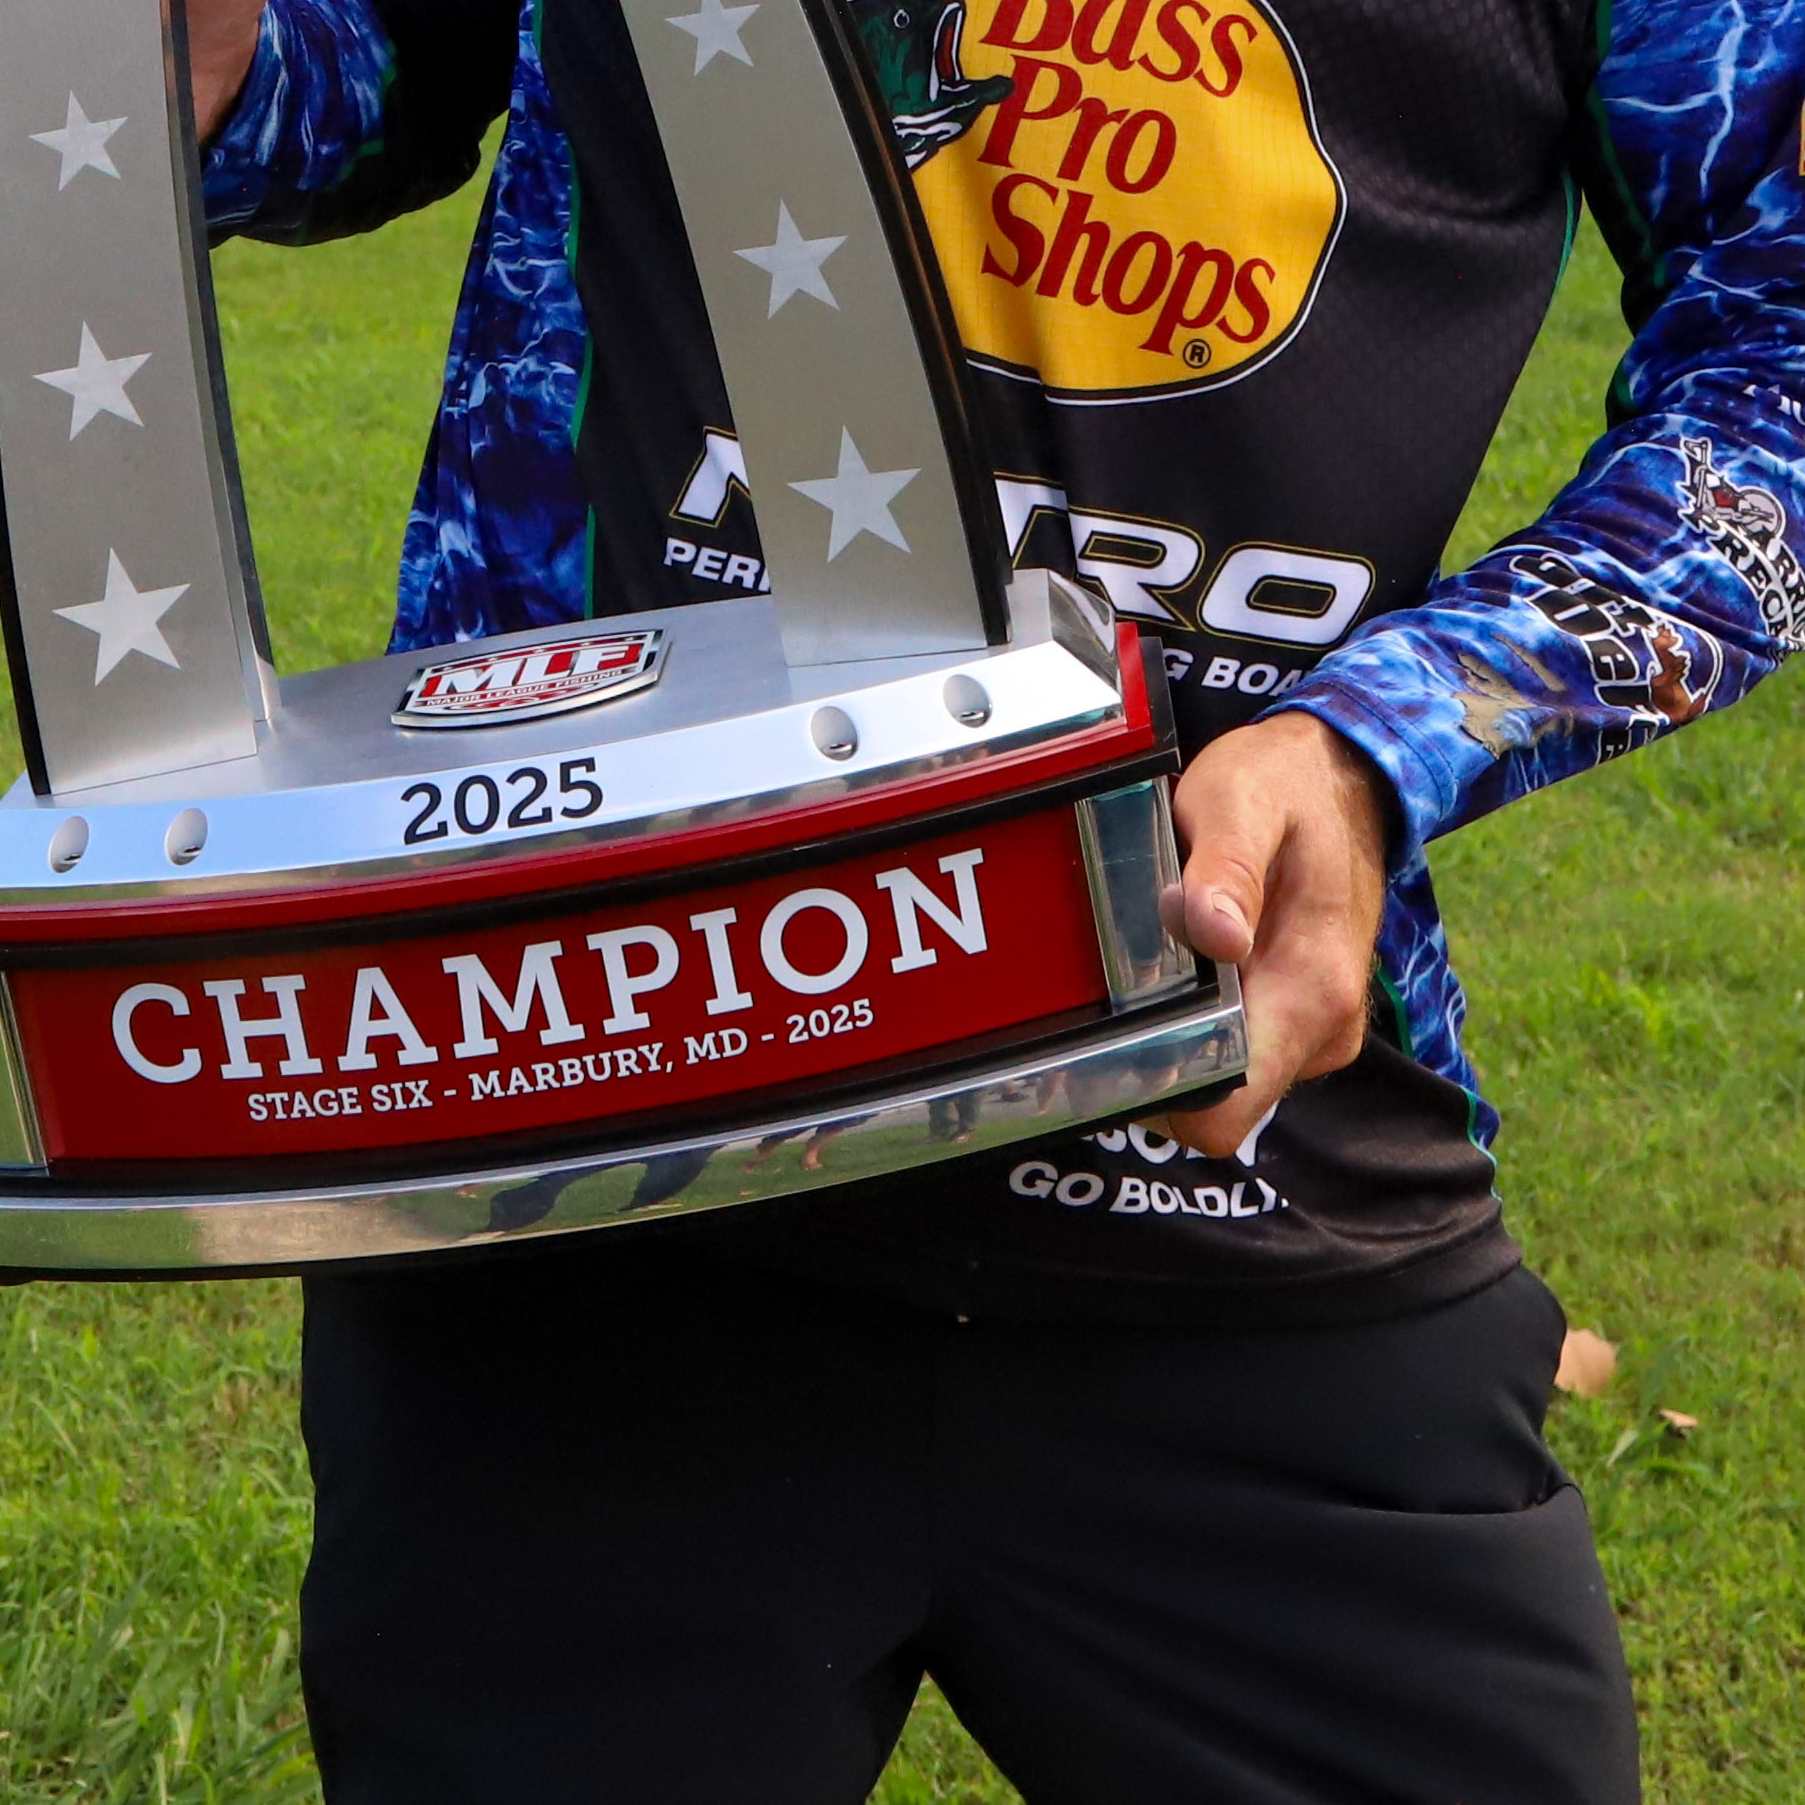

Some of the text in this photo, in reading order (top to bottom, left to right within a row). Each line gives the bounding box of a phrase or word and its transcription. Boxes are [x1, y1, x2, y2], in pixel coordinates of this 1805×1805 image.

[976, 53, 1177, 194] Pro
[980, 173, 1276, 356] Shops
[426, 668, 623, 707] MAJOR LEAGUE FISHING
[433, 644, 631, 696] MLF
[400, 756, 604, 846] 2025
[110, 847, 992, 1085] CHAMPION
[248, 1085, 363, 1122] STAGE
[371, 1079, 434, 1112] SIX
[469, 1042, 674, 1101] MARBURY,
[685, 1027, 749, 1066] MD
[785, 998, 875, 1045] 2025
[1008, 1160, 1105, 1207] GO
